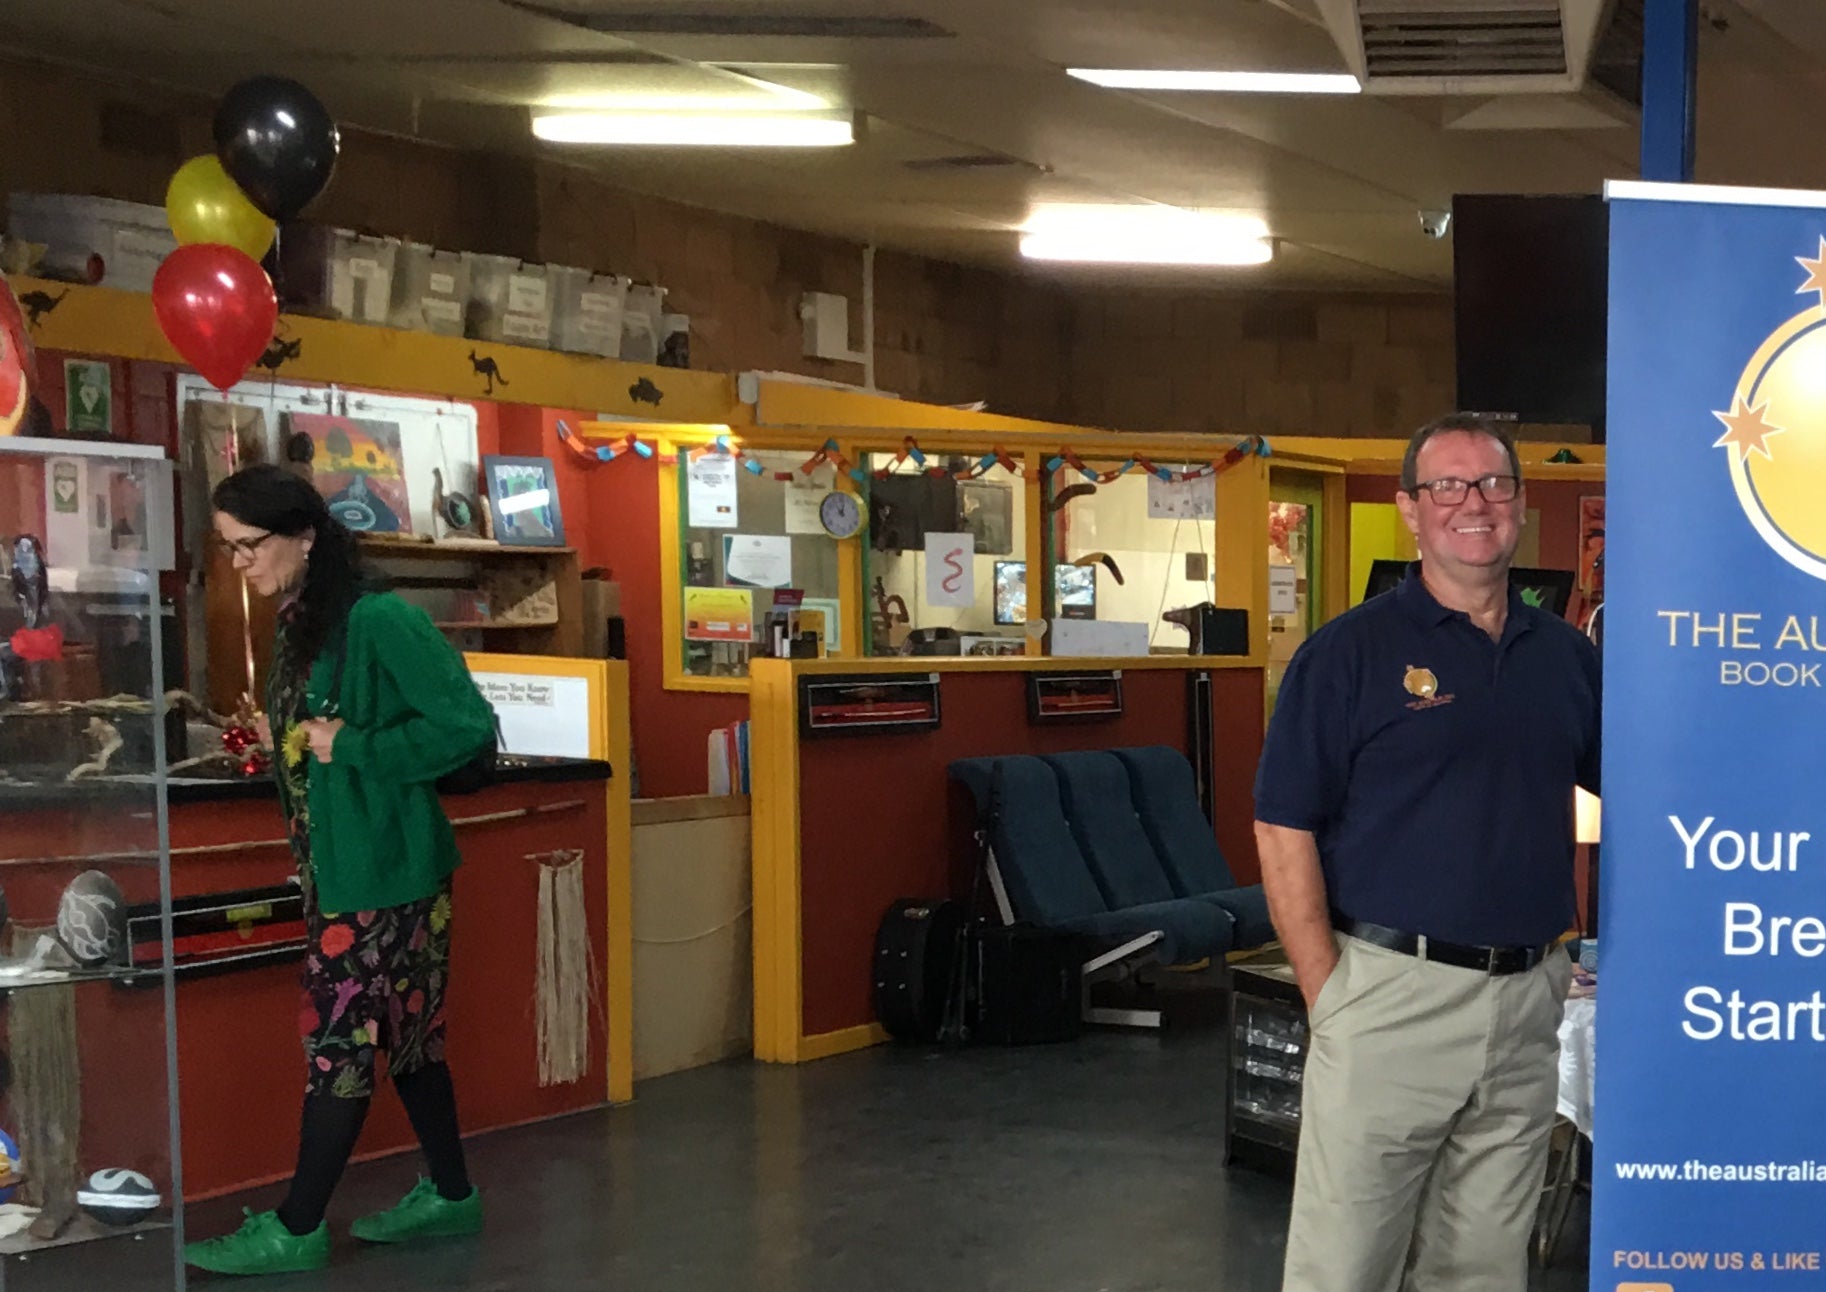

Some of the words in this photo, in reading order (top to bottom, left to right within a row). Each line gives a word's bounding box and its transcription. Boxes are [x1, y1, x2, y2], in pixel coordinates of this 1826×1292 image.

[1657, 609, 1762, 650] THE
[1719, 660, 1821, 688] BOOK
[1667, 815, 1811, 872] Your
[1613, 1249, 1708, 1271] FOLLOW
[1713, 1251, 1744, 1271] US
[1750, 1251, 1766, 1271] &
[1771, 1251, 1820, 1272] LIKE
